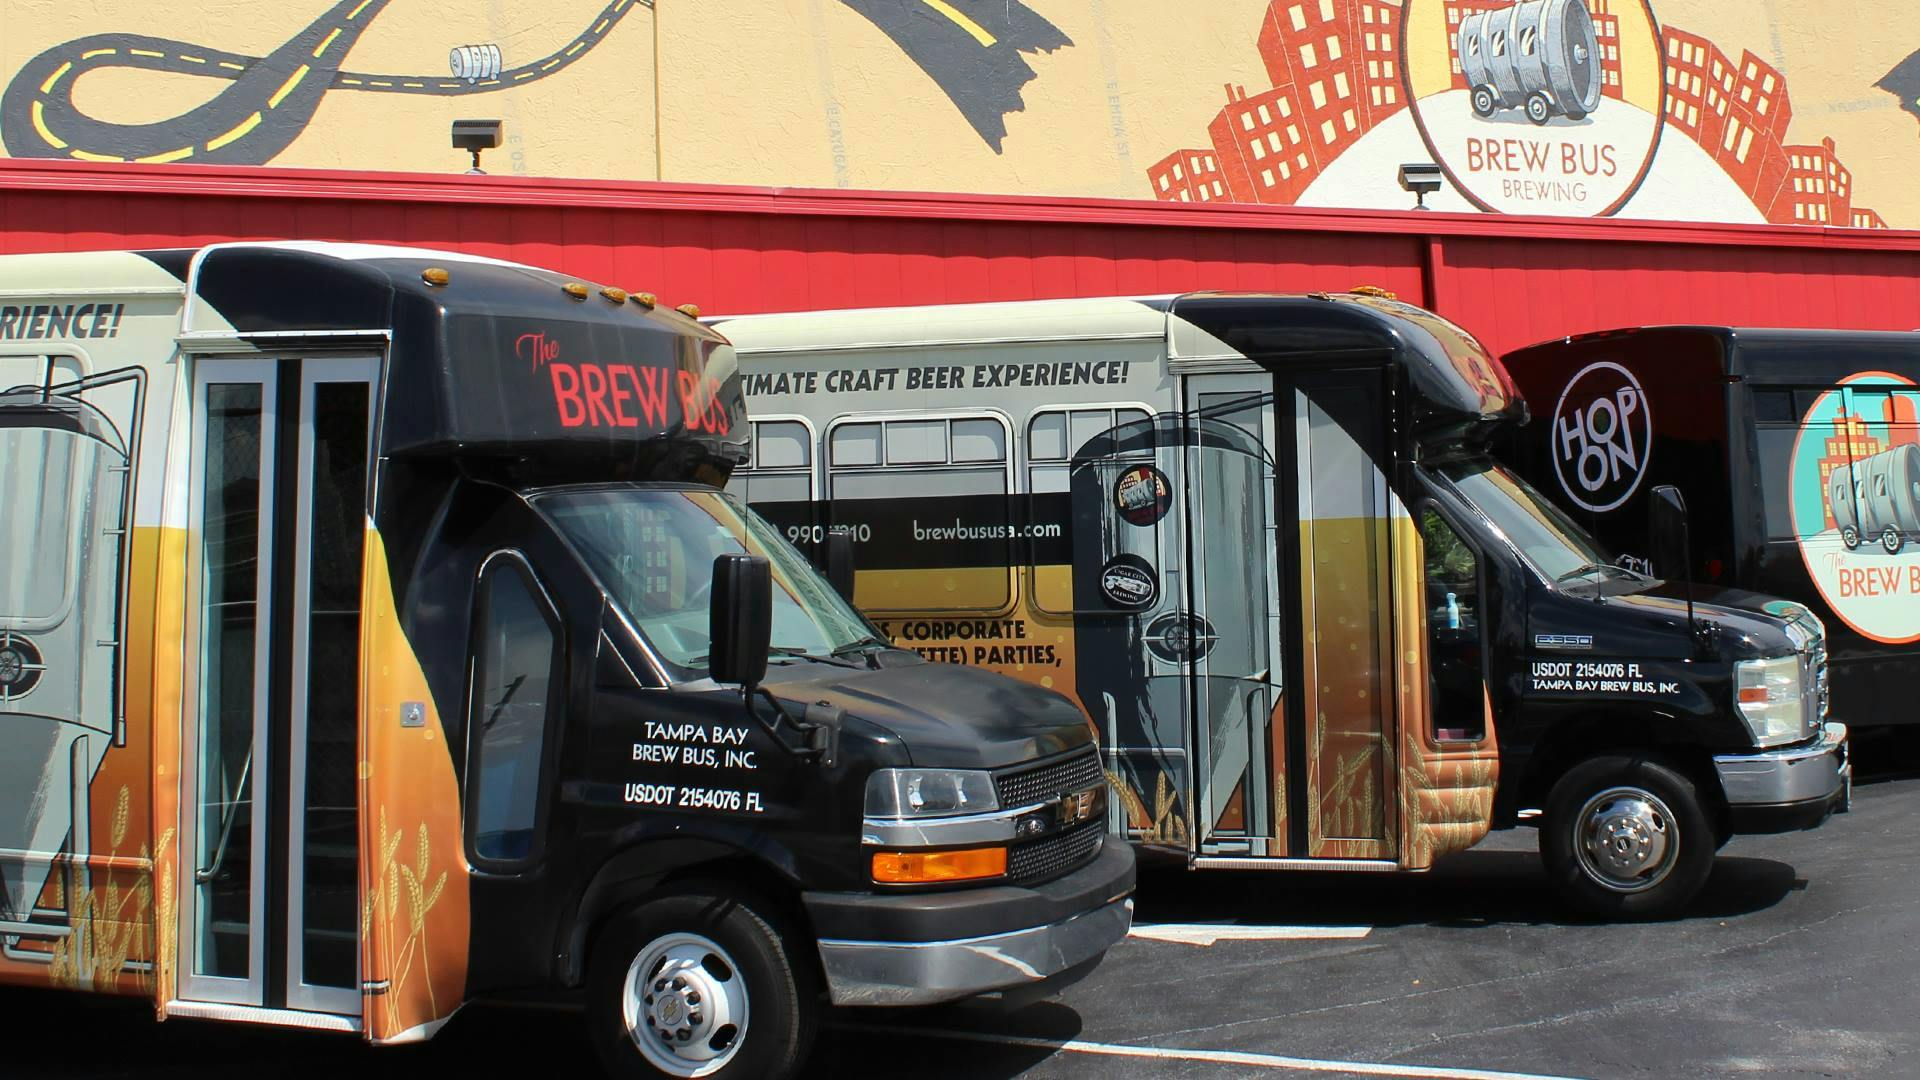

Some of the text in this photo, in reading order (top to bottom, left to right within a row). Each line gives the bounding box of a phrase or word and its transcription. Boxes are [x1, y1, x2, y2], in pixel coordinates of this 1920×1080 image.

[1467, 138, 1617, 177] BREW BUS
[1503, 179, 1587, 202] BREWING
[0, 303, 125, 340] RIENCE!
[515, 331, 560, 374] The
[825, 368, 899, 393] CRAFT
[906, 366, 965, 390] BEER
[972, 361, 1129, 388] EXPERIENCE!
[550, 363, 730, 436] BREW BUS
[1559, 386, 1637, 461] HOP
[1578, 440, 1638, 491] ON
[913, 518, 1061, 541] brewbususa.com
[1839, 566, 1902, 598] BREW
[902, 620, 1026, 641] CORPORATE
[974, 645, 1062, 668] PARTIES,
[1532, 662, 1643, 678] USDOT 2154076 FL
[1532, 679, 1574, 691] TAMPA
[1575, 680, 1599, 691] BAY
[1600, 681, 1631, 692] BREW
[1632, 682, 1657, 694] BUS,
[644, 721, 749, 745] TAMPA BAY
[632, 743, 758, 769] BREW BUS, INC.
[624, 783, 764, 811] USDOT 2154076 FL
